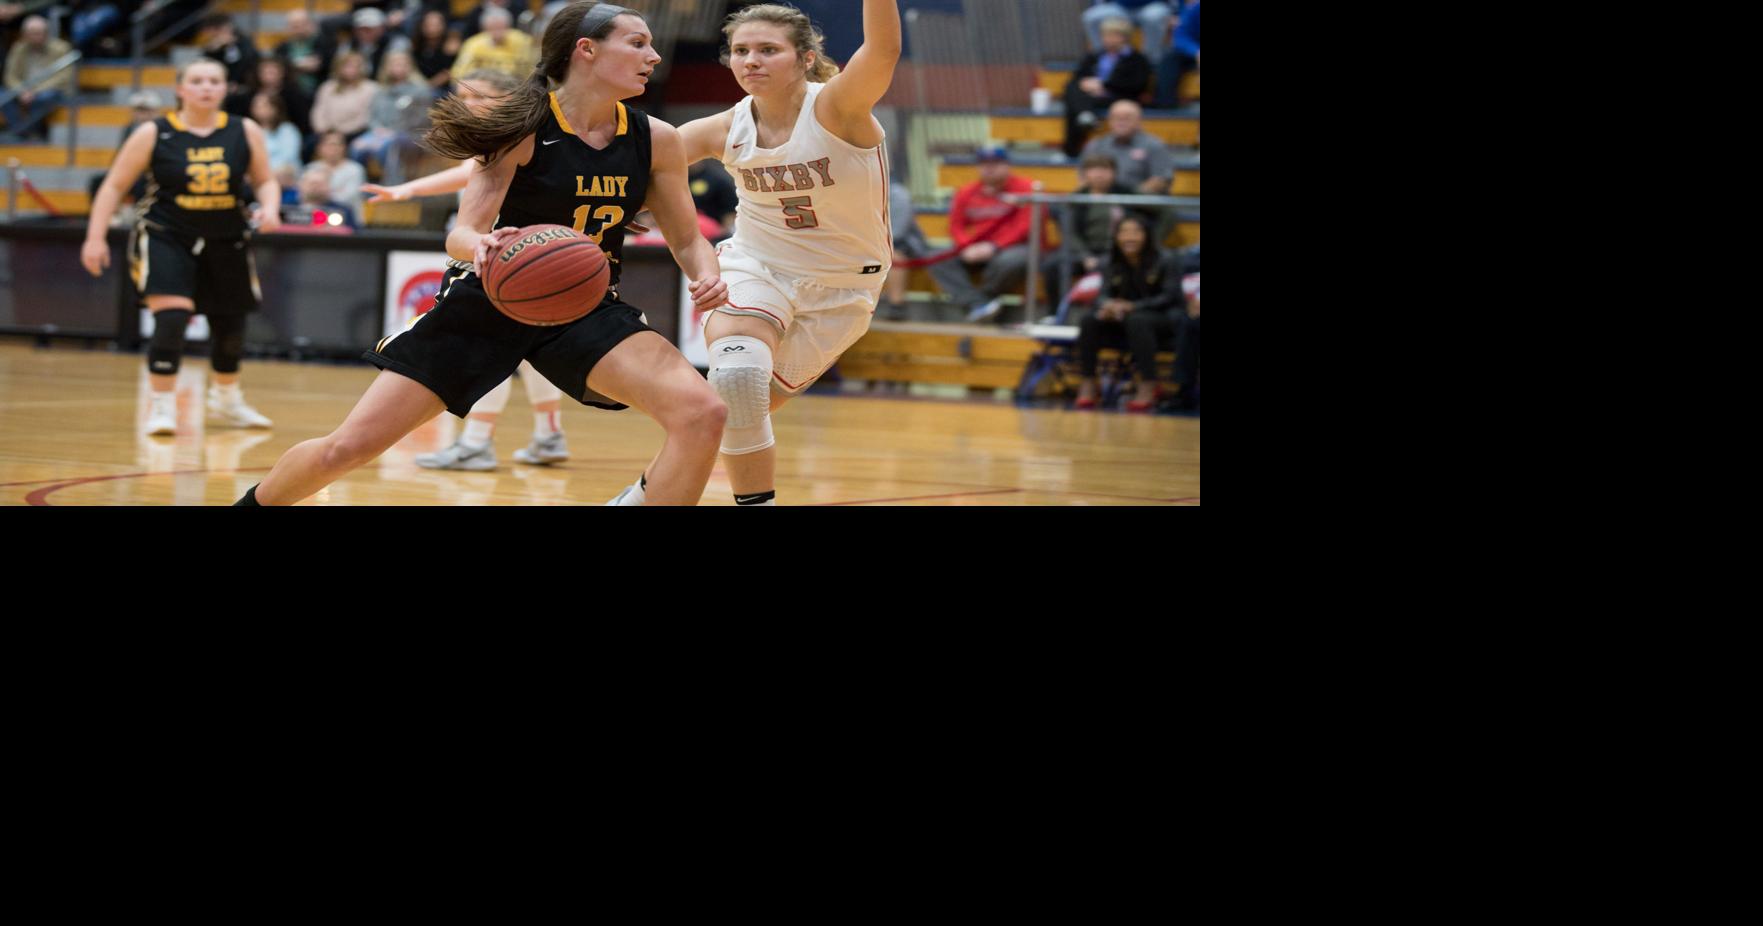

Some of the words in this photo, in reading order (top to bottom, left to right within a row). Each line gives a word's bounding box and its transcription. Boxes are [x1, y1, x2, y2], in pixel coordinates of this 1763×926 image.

[186, 162, 230, 194] 32
[576, 175, 629, 197] LADY
[738, 156, 835, 192] BIXBY
[778, 195, 819, 230] 5
[500, 227, 578, 263] Wilson
